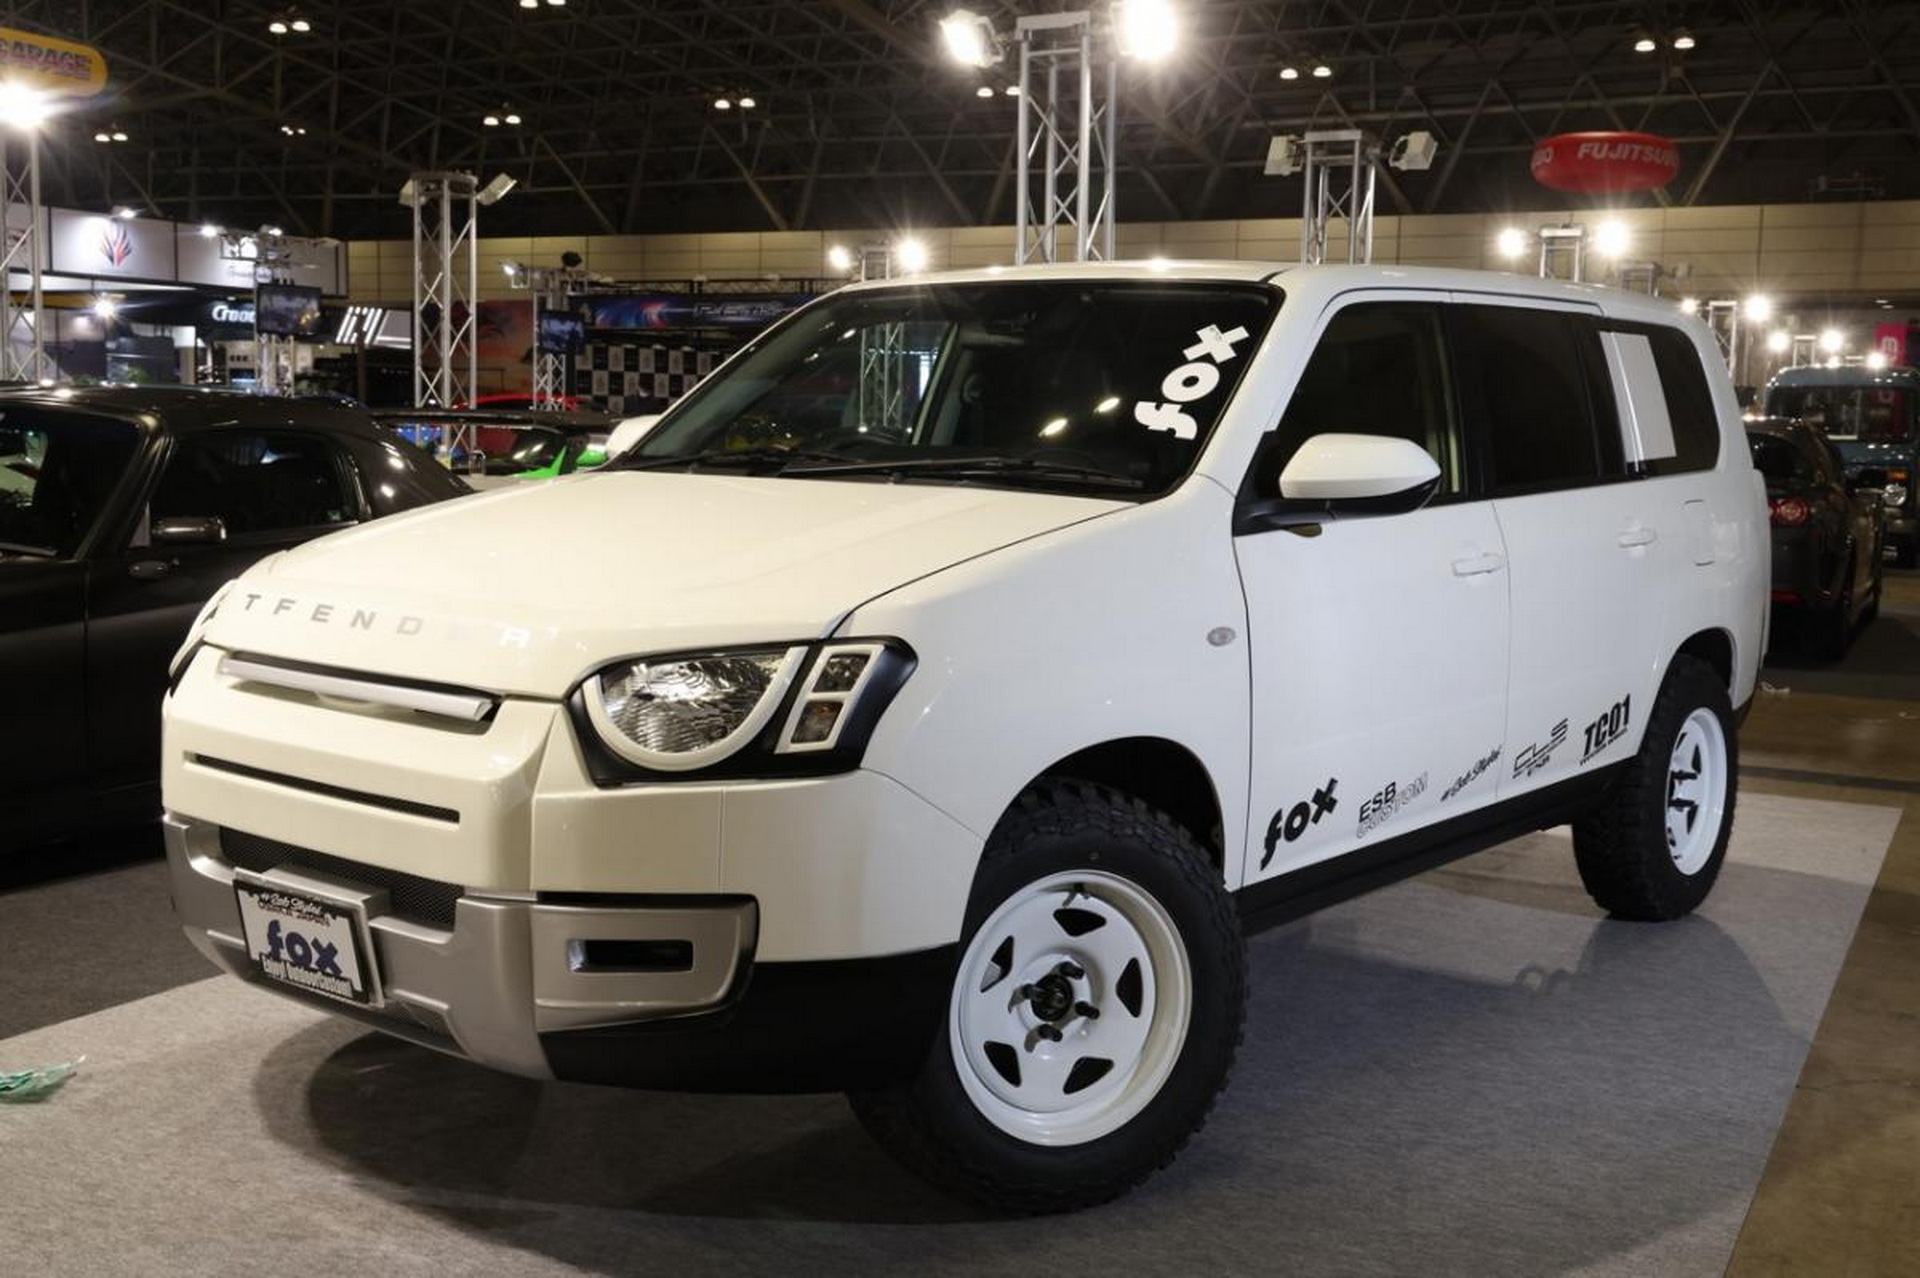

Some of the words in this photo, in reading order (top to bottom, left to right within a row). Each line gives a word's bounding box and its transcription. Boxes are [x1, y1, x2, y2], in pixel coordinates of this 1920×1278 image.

[1134, 324, 1250, 440] fox
[1583, 692, 1630, 757] TC01
[1259, 776, 1338, 871] fox
[1358, 781, 1397, 823] ESB
[266, 918, 343, 976] fox
